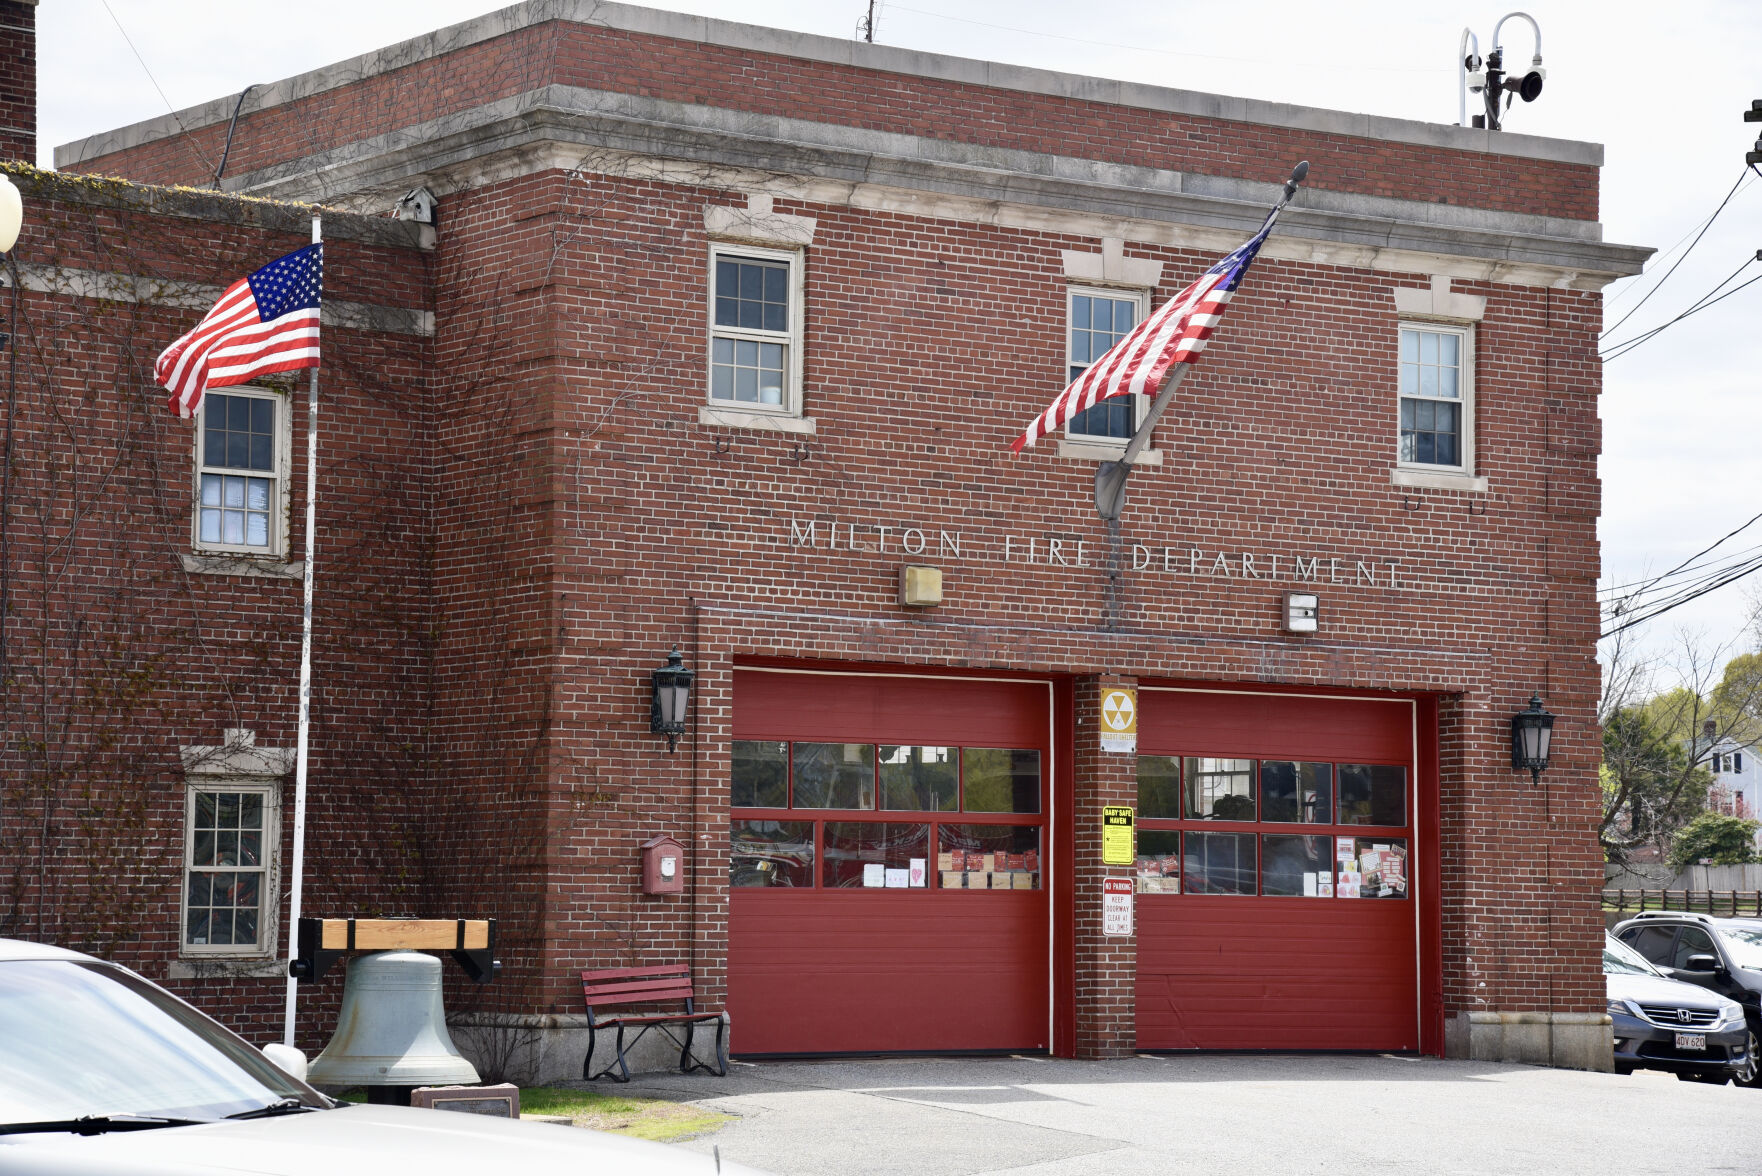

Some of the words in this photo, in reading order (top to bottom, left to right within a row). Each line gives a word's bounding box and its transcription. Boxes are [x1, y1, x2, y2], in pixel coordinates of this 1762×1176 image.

[790, 519, 960, 559] MILTON
[1004, 534, 1091, 567] FIRE
[1132, 543, 1401, 588] DEPARTMENT
[1119, 809, 1132, 817] SAFE
[1109, 817, 1127, 825] HAVEN
[1105, 882, 1112, 890] NO
[1113, 882, 1131, 891] PARKING
[1111, 895, 1124, 903] KEEP
[1106, 904, 1129, 912] DOORWAY
[1107, 914, 1120, 922] CLEAR
